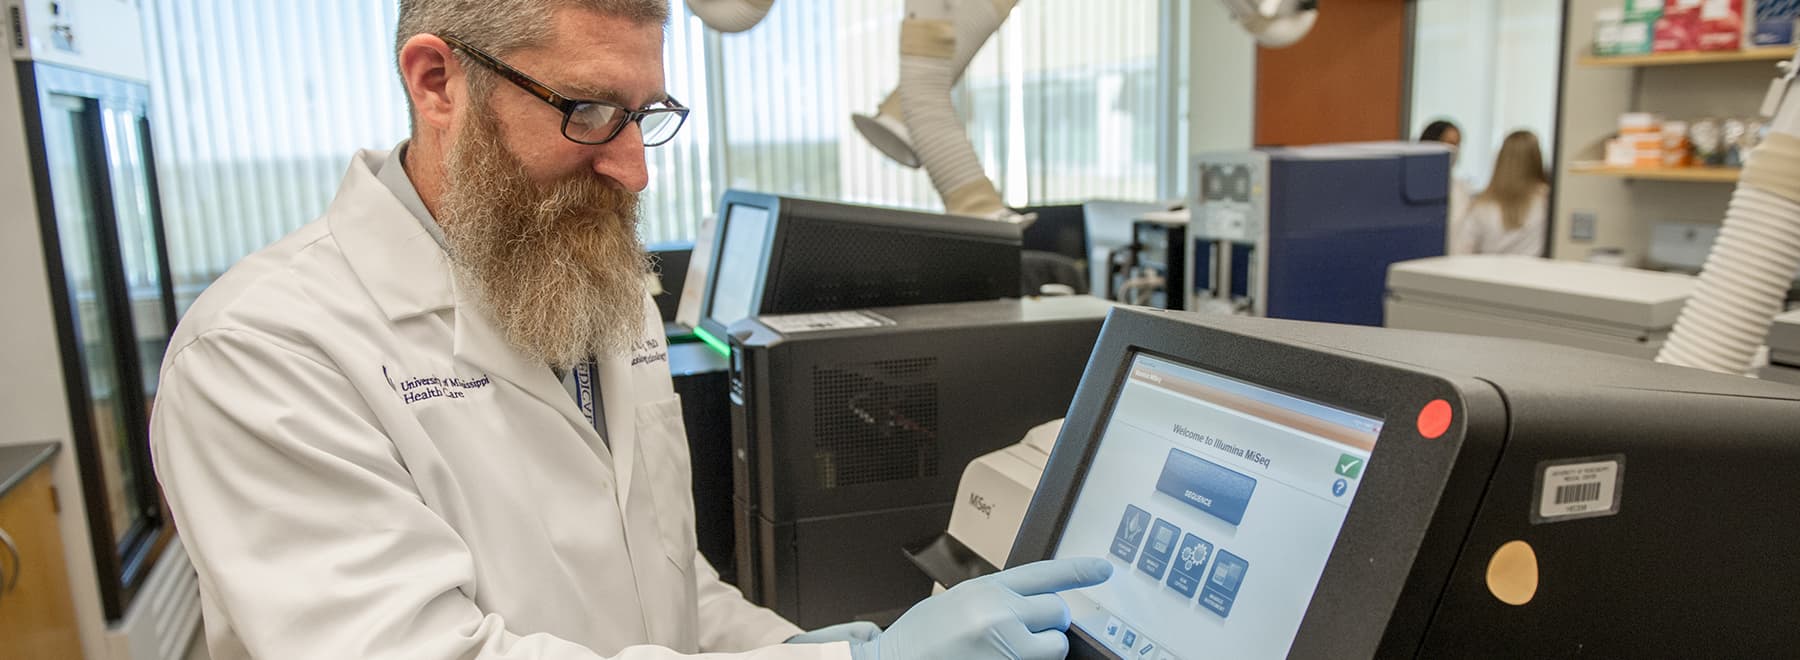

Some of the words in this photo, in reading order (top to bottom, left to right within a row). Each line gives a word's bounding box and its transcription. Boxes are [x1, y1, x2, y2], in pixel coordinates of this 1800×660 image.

[450, 374, 490, 389] Miissippi
[403, 386, 443, 404] Health
[443, 387, 464, 399] Care
[1173, 423, 1205, 441] Welcome
[1204, 436, 1214, 447] to
[1213, 438, 1244, 458] Illumina
[1245, 449, 1271, 470] MiSeq
[1184, 489, 1213, 507] SEQUENCE
